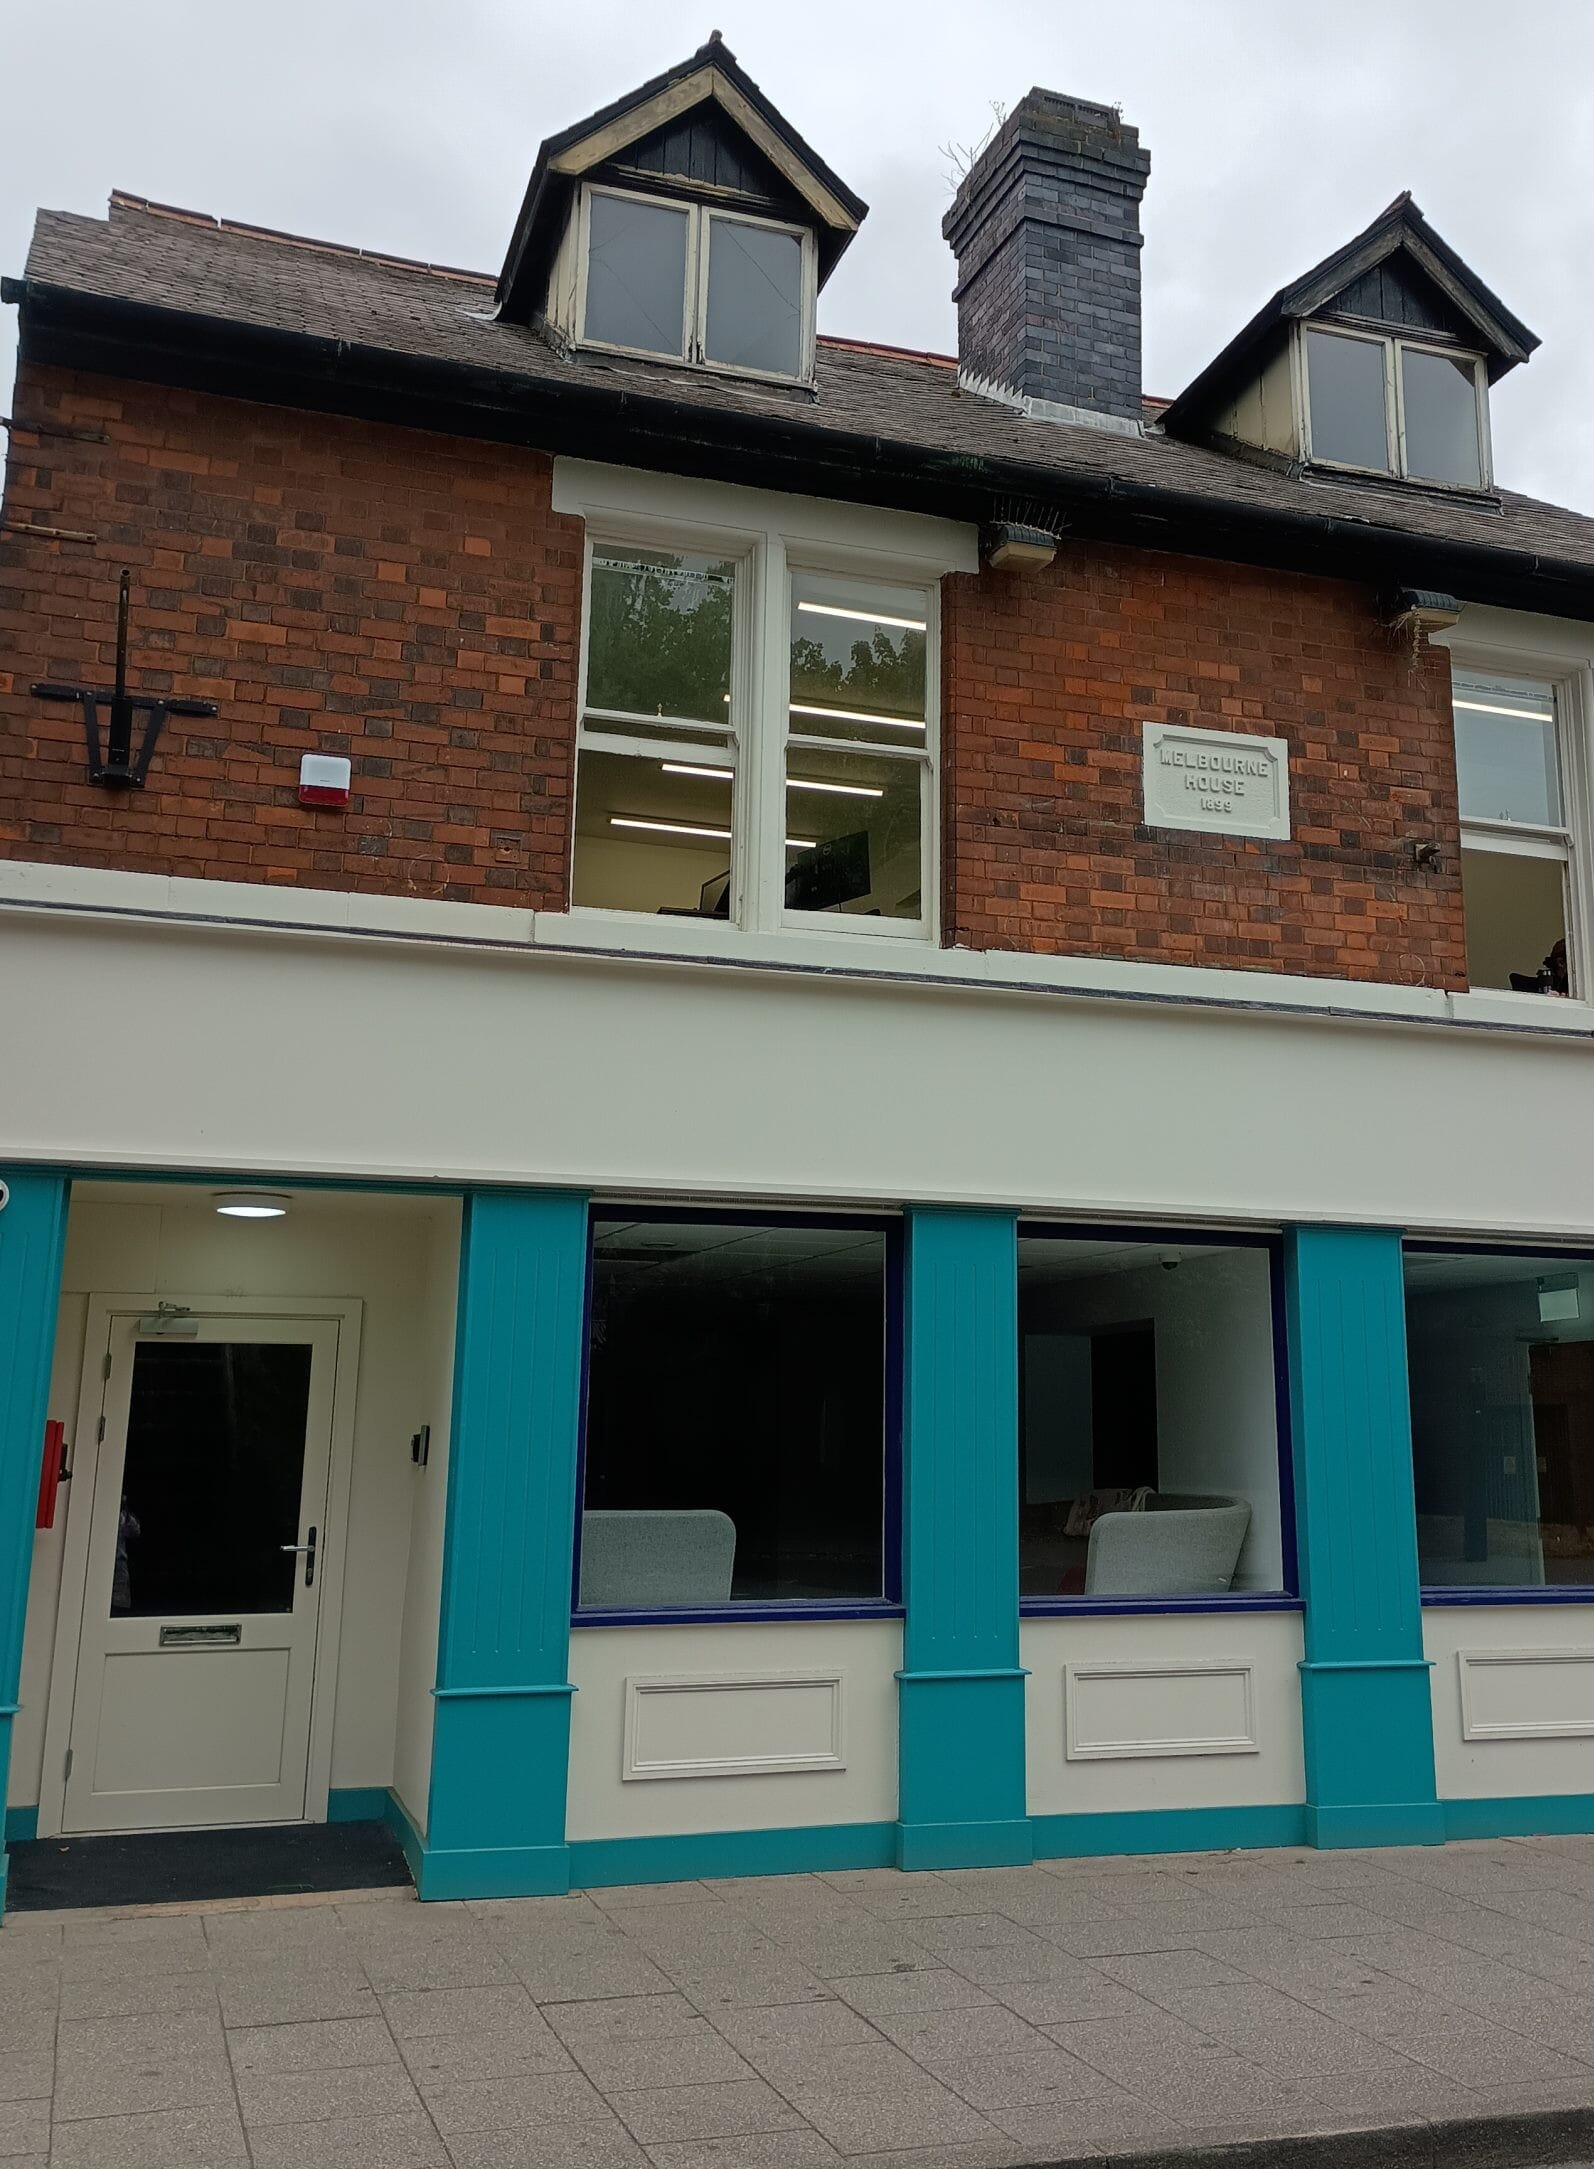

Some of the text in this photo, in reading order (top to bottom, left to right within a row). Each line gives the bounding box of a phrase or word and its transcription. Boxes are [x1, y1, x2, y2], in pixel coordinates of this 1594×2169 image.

[1160, 749, 1268, 777] MELBOURNE
[1185, 774, 1245, 796] HOUSE
[1200, 798, 1232, 813] 1899
